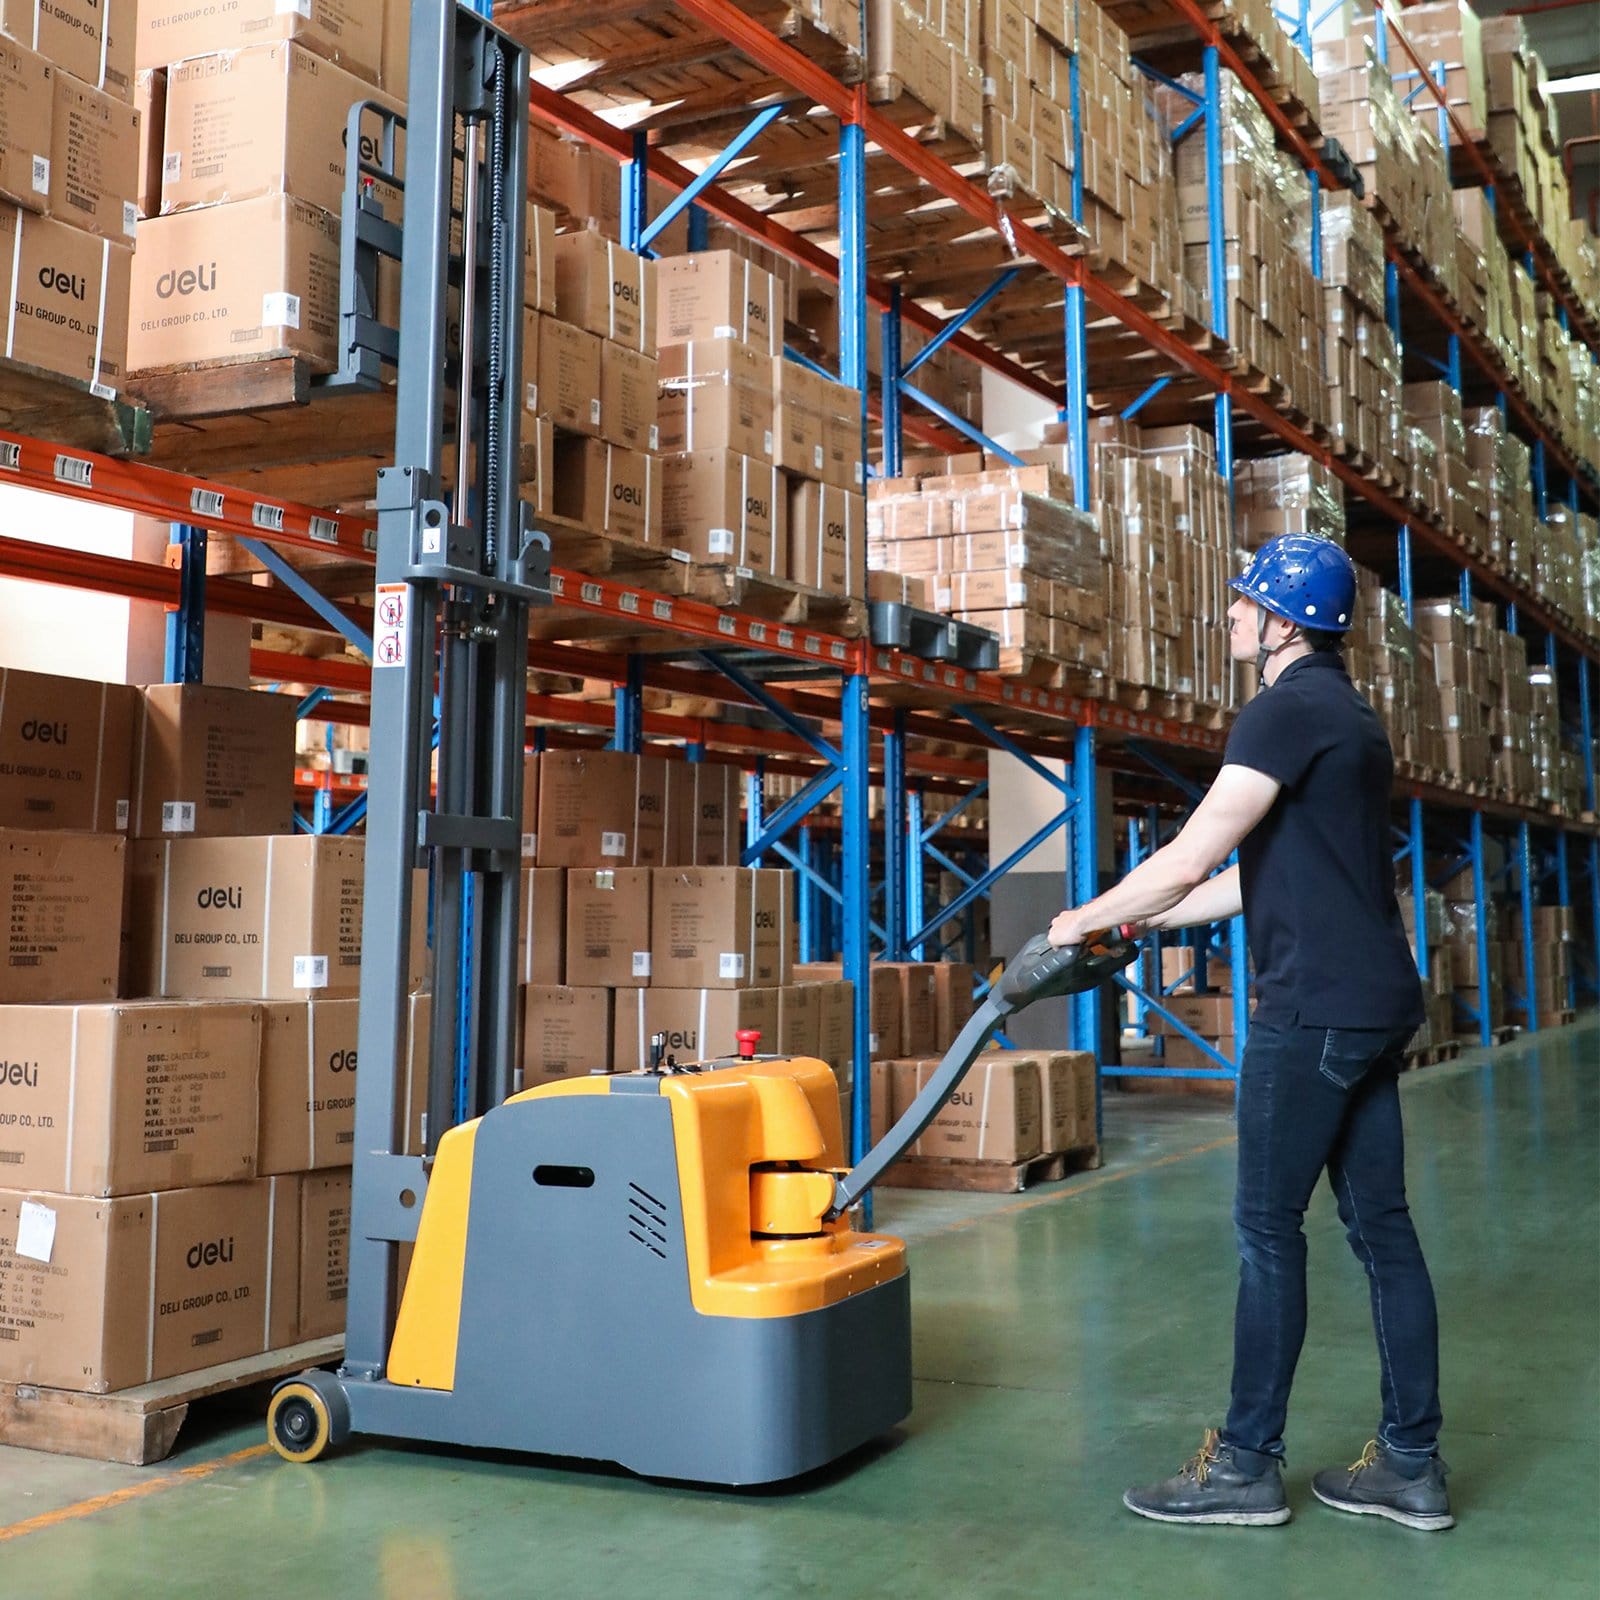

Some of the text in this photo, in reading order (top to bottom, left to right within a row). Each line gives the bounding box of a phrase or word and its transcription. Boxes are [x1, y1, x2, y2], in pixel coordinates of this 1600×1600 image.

[38, 1, 53, 14] ELI
[54, 7, 82, 28] GROUP
[151, 17, 170, 29] DELI
[172, 9, 201, 24] GROUP
[44, 67, 50, 79] E
[132, 116, 137, 127] E
[342, 127, 383, 168] el
[39, 267, 85, 301] deli
[156, 262, 216, 299] deli
[613, 280, 639, 306] deli
[36, 307, 66, 325] GROUP
[87, 324, 98, 337] LT
[141, 319, 160, 331] DELI
[161, 314, 191, 328] GROUP
[747, 301, 767, 324] deli
[613, 484, 642, 507] deli
[746, 497, 768, 519] deli
[827, 522, 847, 541] del
[22, 720, 68, 745] deli
[0, 763, 14, 775] ELI
[16, 765, 47, 777] GROUP
[197, 886, 242, 909] deli
[174, 933, 192, 944] DELI
[194, 933, 223, 944] GROUP
[243, 933, 261, 944] LTD.
[9, 945, 28, 953] MADE
[38, 945, 58, 953] CHINA
[147, 1053, 169, 1062] DESC.:
[330, 1049, 357, 1073] de
[146, 1075, 170, 1084] COLOR:
[326, 1097, 356, 1110] GROUP
[949, 1091, 973, 1106] eli
[0, 1113, 17, 1125] OUP
[38, 1116, 55, 1128] LTD.
[144, 1126, 196, 1138] MADE IN CHINA
[187, 1236, 234, 1269] deli
[160, 1302, 180, 1315] DELI
[182, 1294, 213, 1310] GROUP
[8, 1317, 15, 1325] IN
[16, 1318, 36, 1328] CHINA
